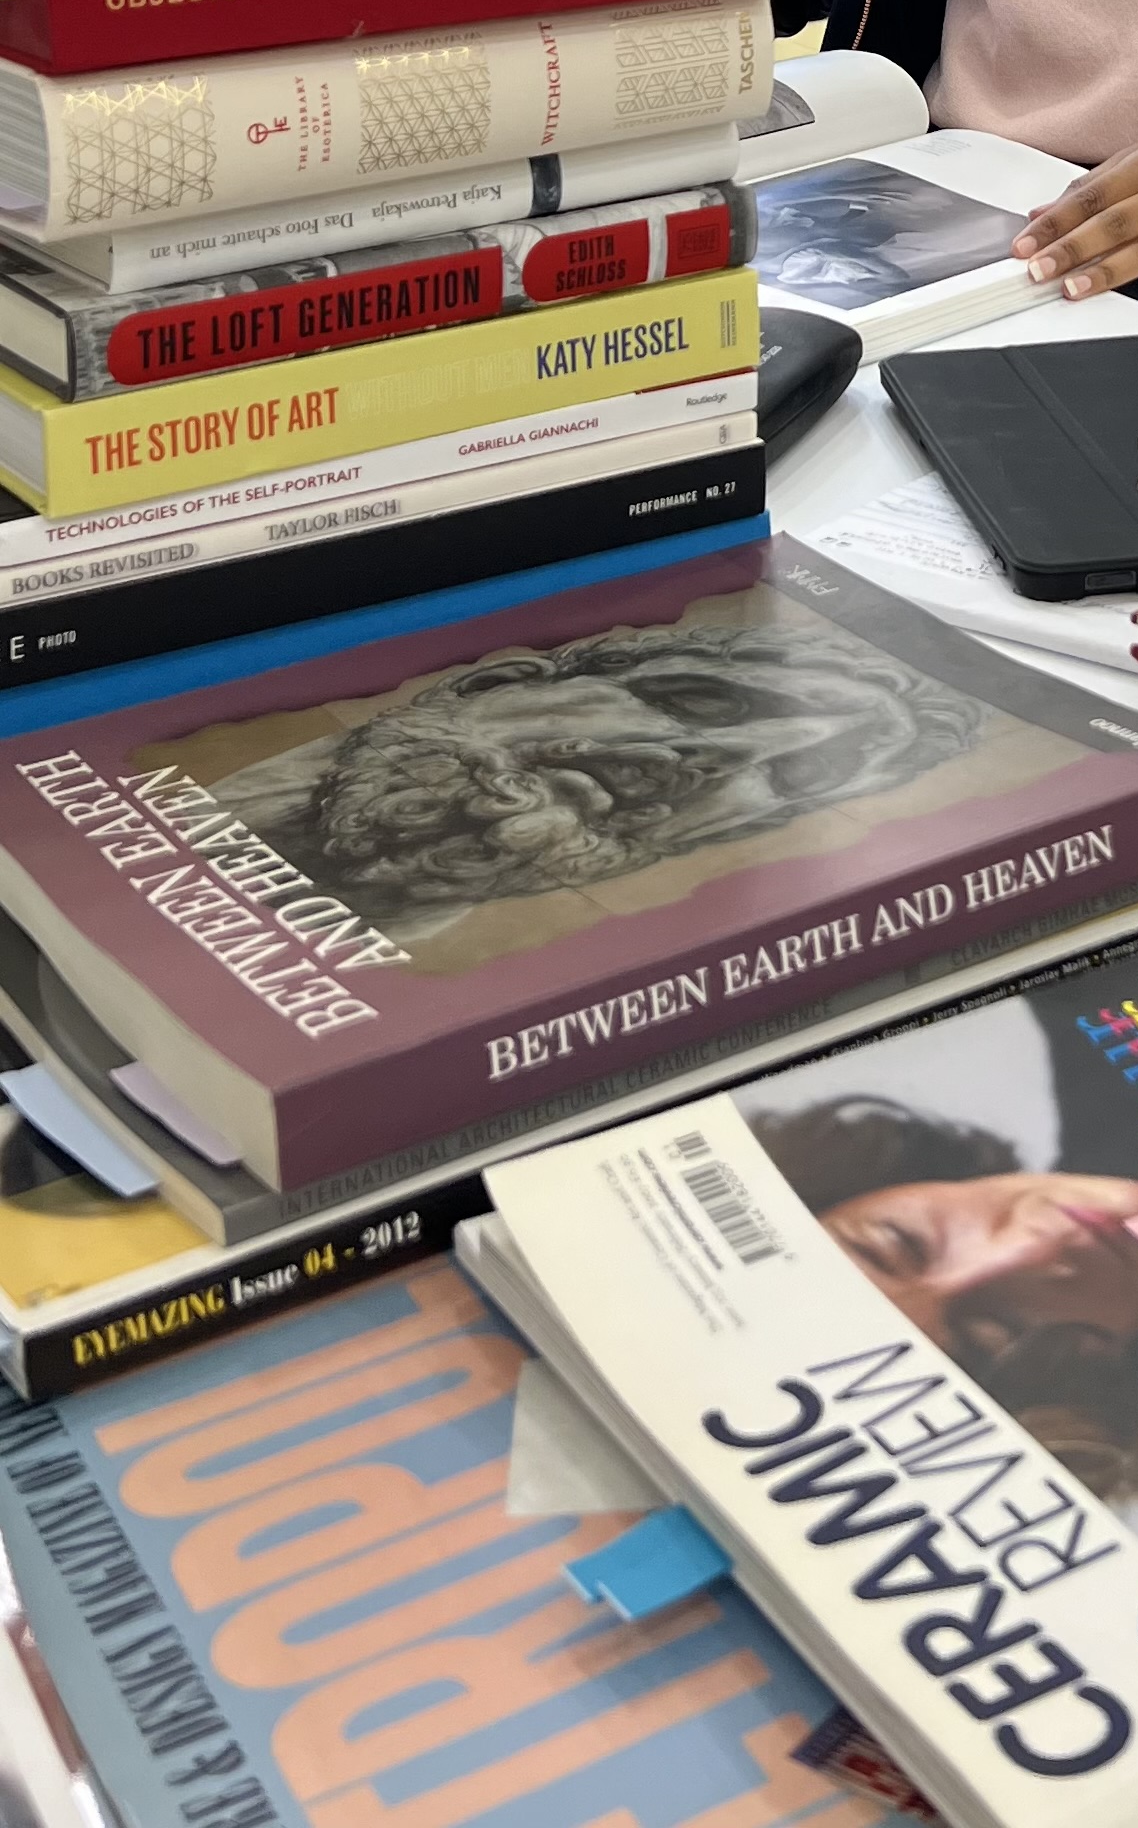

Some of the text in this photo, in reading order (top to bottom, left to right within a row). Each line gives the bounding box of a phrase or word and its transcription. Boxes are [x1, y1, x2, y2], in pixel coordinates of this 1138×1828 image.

[538, 21, 562, 146] WITCHCRAFT
[735, 11, 755, 95] TASCHEN
[294, 75, 309, 172] THE LIBRARY
[311, 115, 321, 134] OF
[320, 81, 331, 164] ESOTERICA
[150, 212, 354, 261] Das Foto schaute mich an
[371, 183, 503, 219] Katja Petrowskaja
[555, 258, 627, 293] SCHLOSS
[568, 233, 615, 265] EDITH
[137, 265, 481, 370] THE LOFT GENERATION
[535, 316, 691, 381] KATY HESSEL
[84, 428, 143, 475] THE
[148, 407, 240, 463] STORY
[247, 398, 281, 442] OF
[288, 386, 340, 433] ART
[458, 417, 600, 457] GABRIELLA GIANNACHI
[686, 392, 729, 408] Routledge
[45, 465, 363, 543] TECHNOLOGIES OF THE SELF-PORTRAIT
[263, 497, 401, 543] TAYLOR FISCH
[628, 480, 737, 517] PERFORMANCE NO. 27
[12, 541, 197, 597] BOOKS REVISITED
[38, 629, 78, 652] PHOTO
[14, 748, 380, 1040] BETWEEN EARTH
[115, 764, 413, 972] AND HEAVEN
[484, 965, 710, 1082] BETWEEN
[719, 913, 864, 999] EARTH
[871, 883, 955, 947] AND
[964, 824, 1117, 912] HEAVEN
[278, 1142, 451, 1219] INTERNATIONAL
[458, 1082, 620, 1152] ARCHITECTURAL
[626, 1040, 712, 1090] CERAMIC
[717, 999, 832, 1054] CONFERENCE
[72, 1289, 226, 1368] EYEMAZING
[229, 1261, 301, 1308] Issue
[303, 1242, 339, 1280] 04
[359, 1210, 424, 1261] 2012
[5, 1450, 88, 1495] OF
[25, 1480, 168, 1637] MAGAZINE
[700, 1341, 1135, 1778] CERAMIC REVIEW
[103, 1624, 231, 1759] DESIGN
